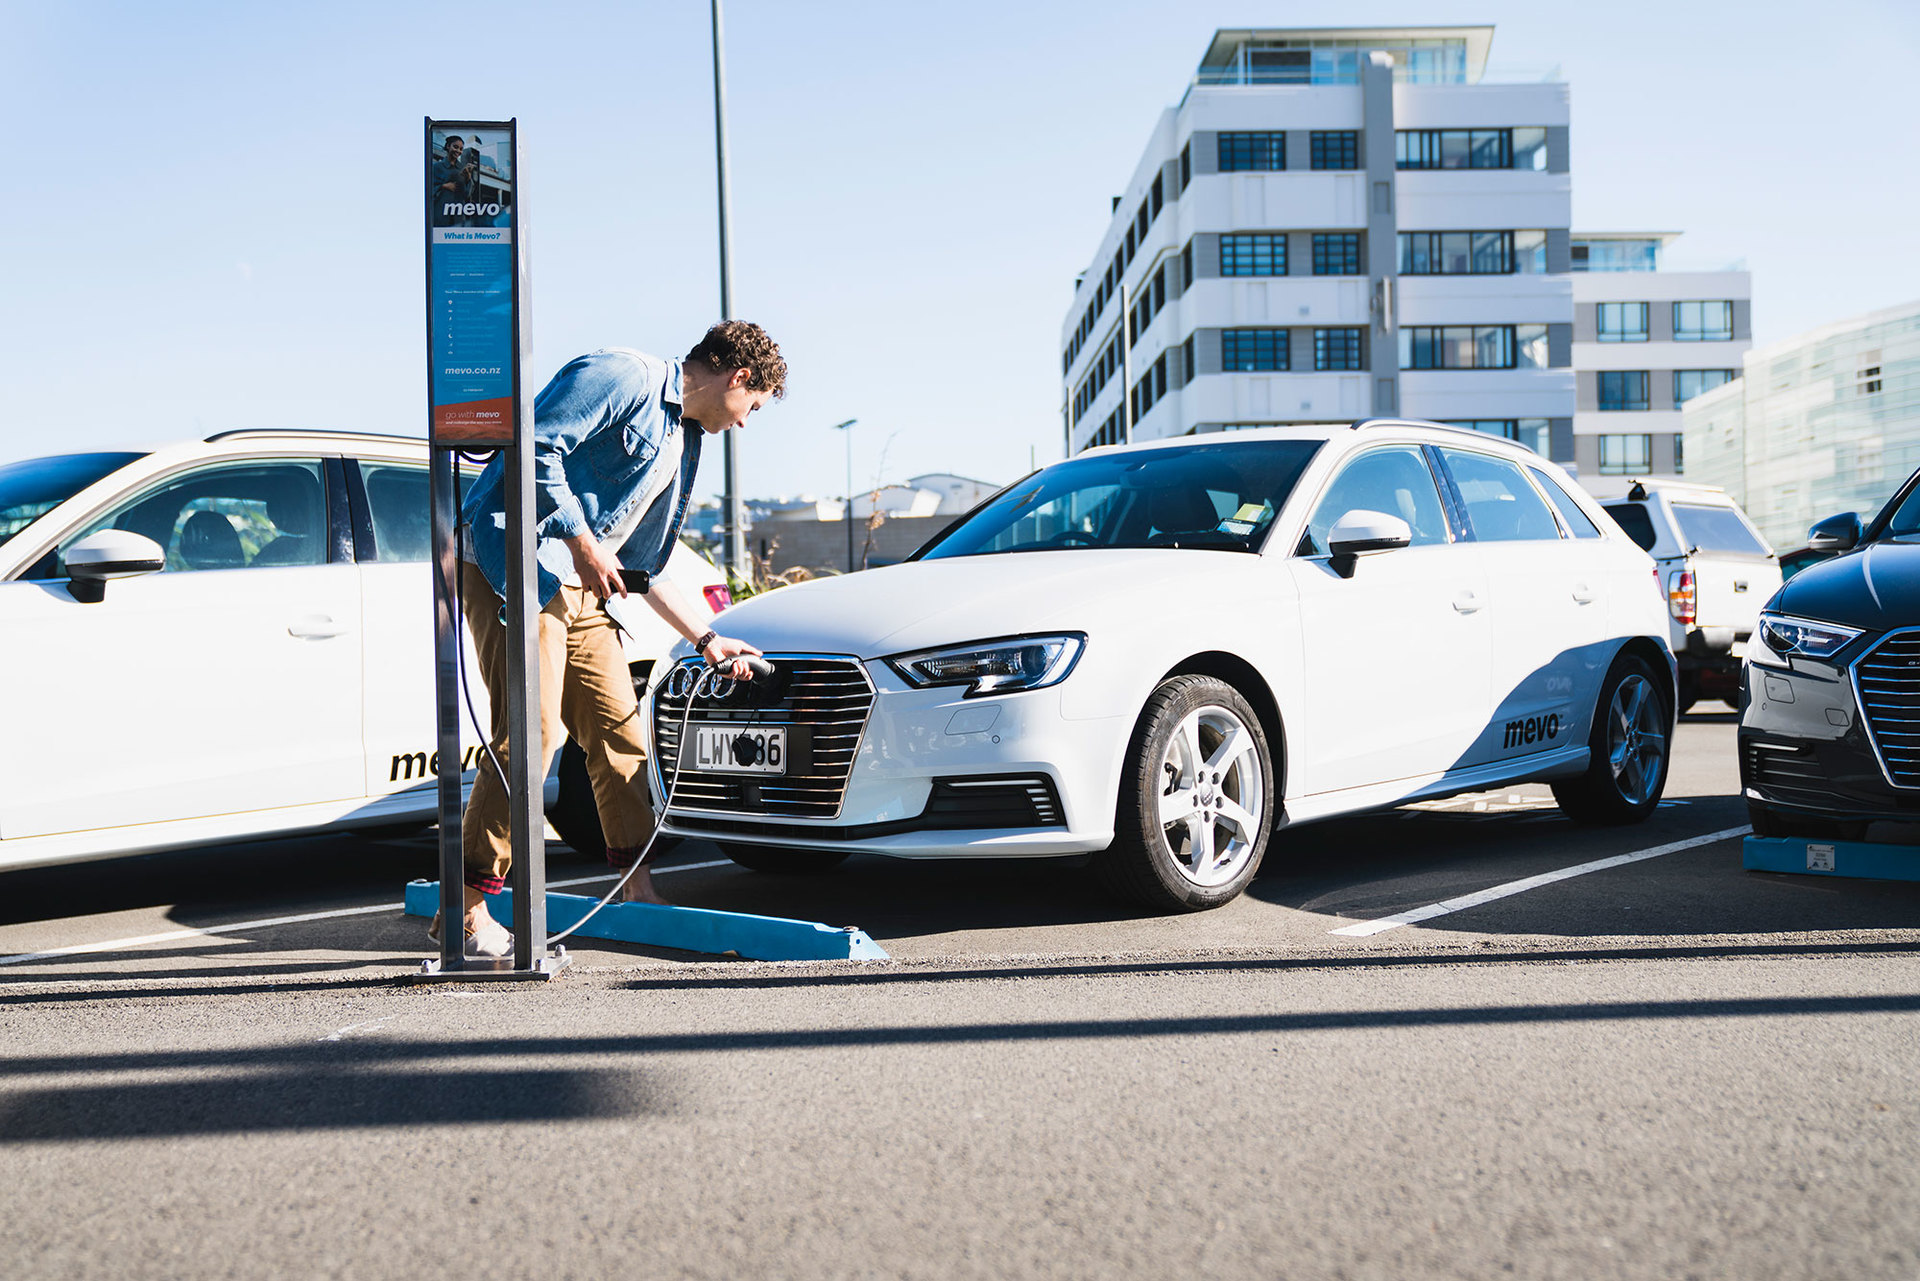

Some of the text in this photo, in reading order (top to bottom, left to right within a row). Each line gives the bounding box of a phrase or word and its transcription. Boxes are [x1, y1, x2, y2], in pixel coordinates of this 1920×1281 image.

[443, 202, 500, 216] mevo
[444, 232, 501, 240] What is Mevo?
[445, 367, 501, 375] mevo.co.nz
[445, 412, 457, 420] go
[1503, 713, 1559, 749] mevo
[699, 733, 781, 767] LWY86
